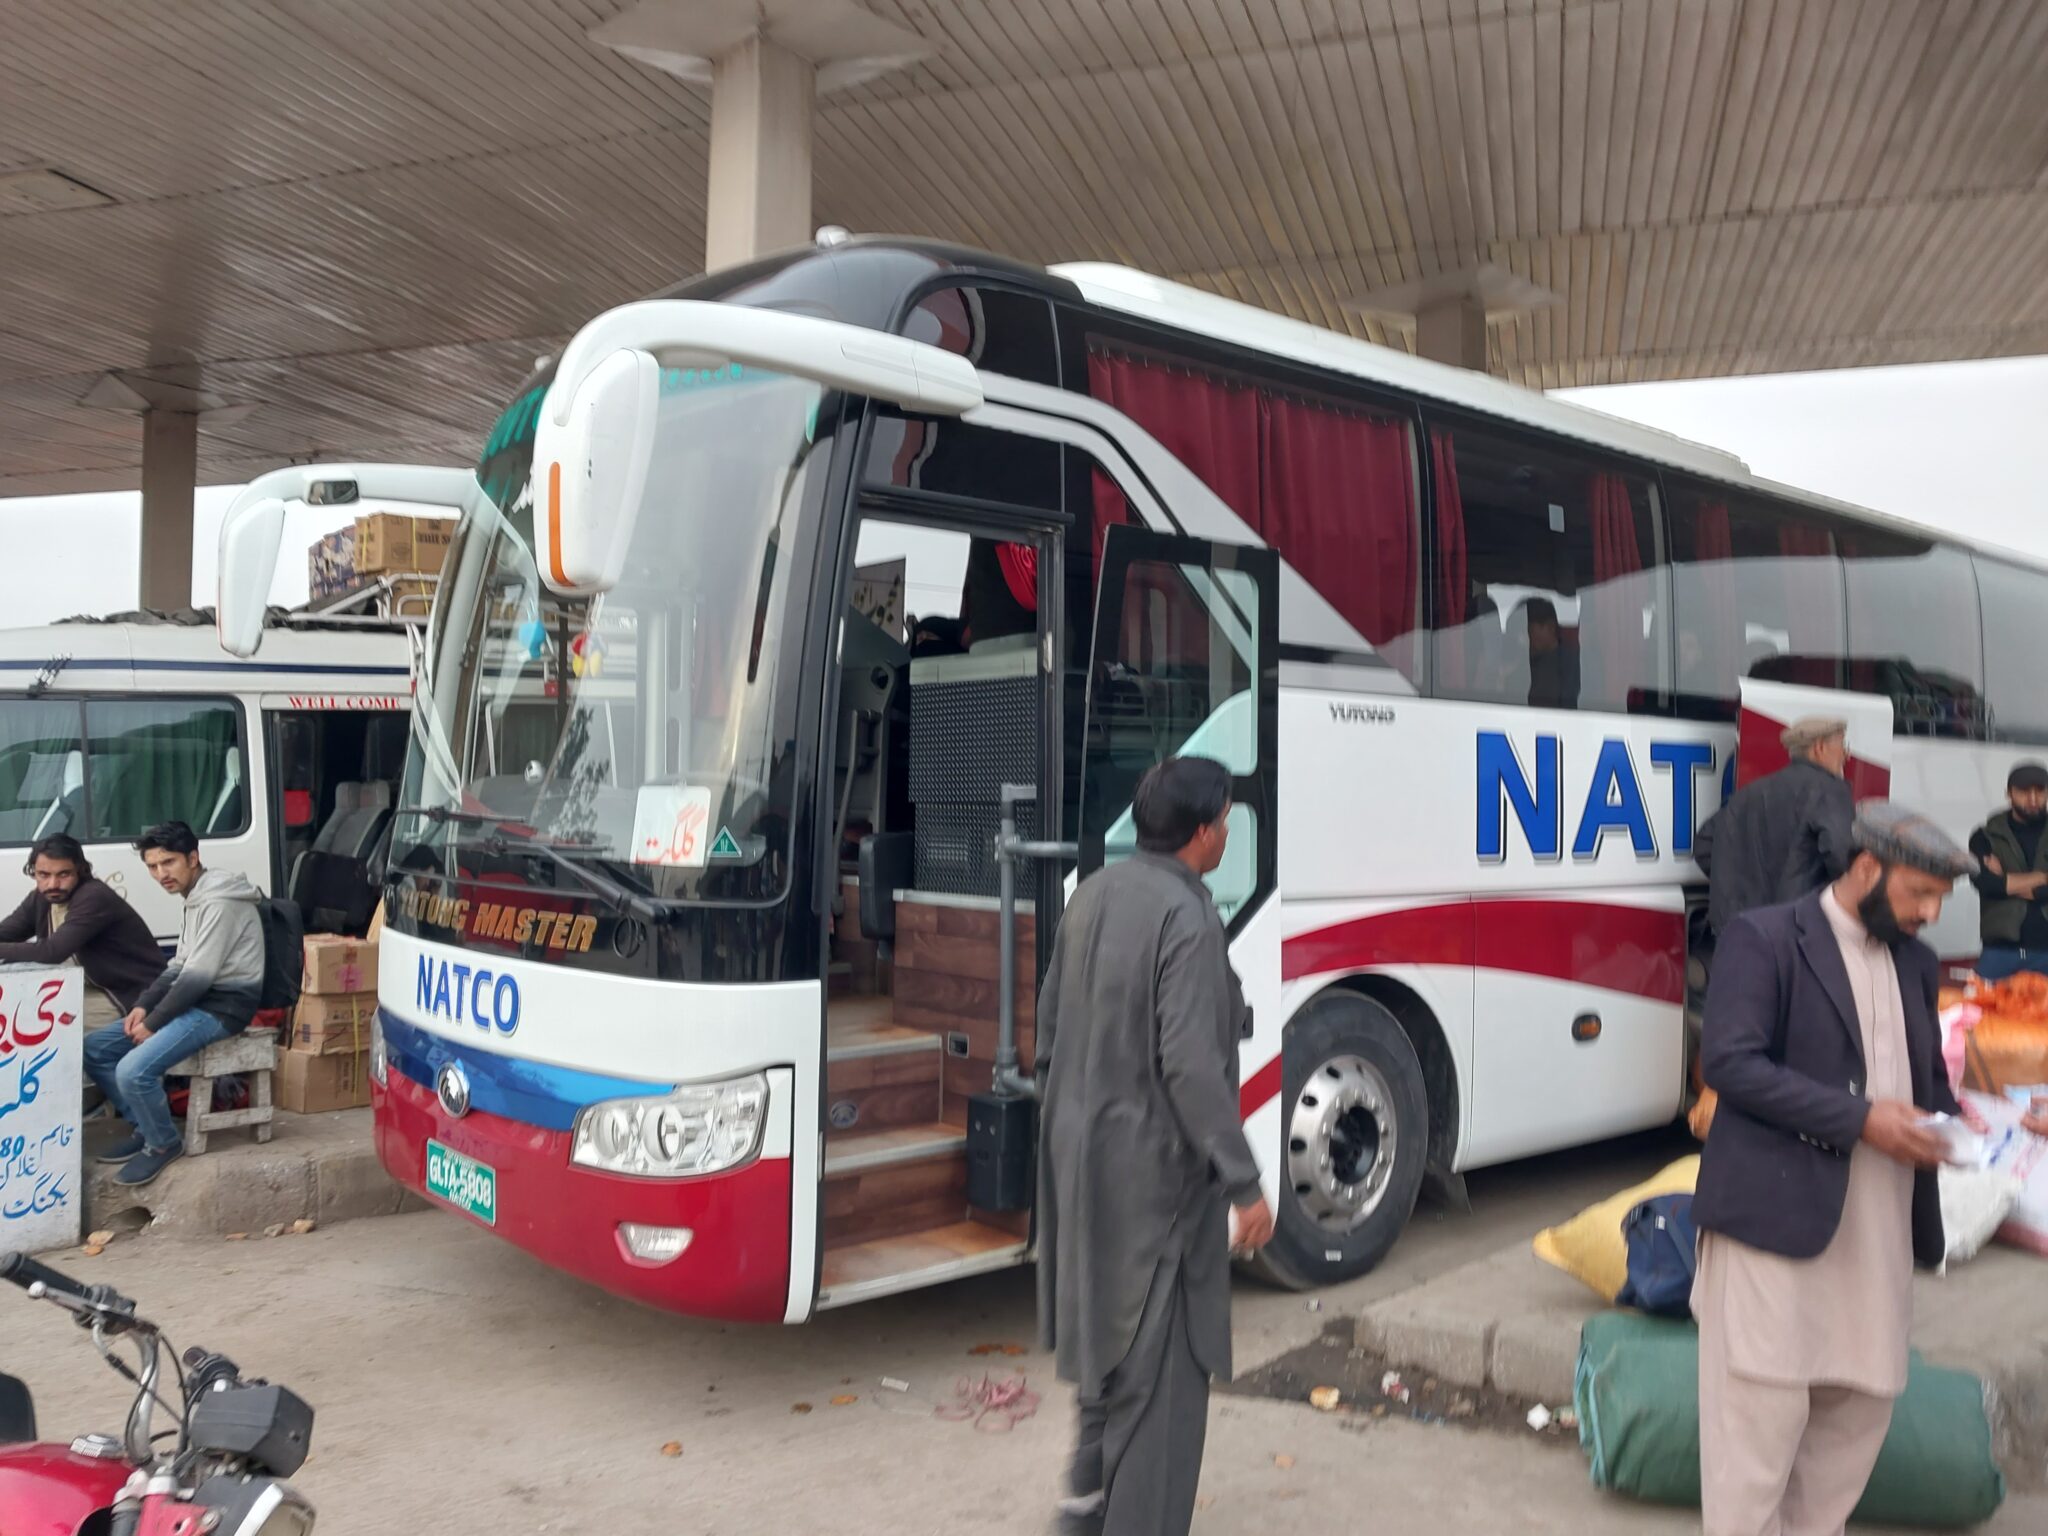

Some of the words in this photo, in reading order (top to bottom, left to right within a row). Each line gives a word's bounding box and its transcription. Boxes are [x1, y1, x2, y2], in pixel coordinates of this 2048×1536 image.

[1476, 729, 1738, 863] NAT
[472, 903, 598, 952] MASTER
[416, 953, 521, 1039] NATCO
